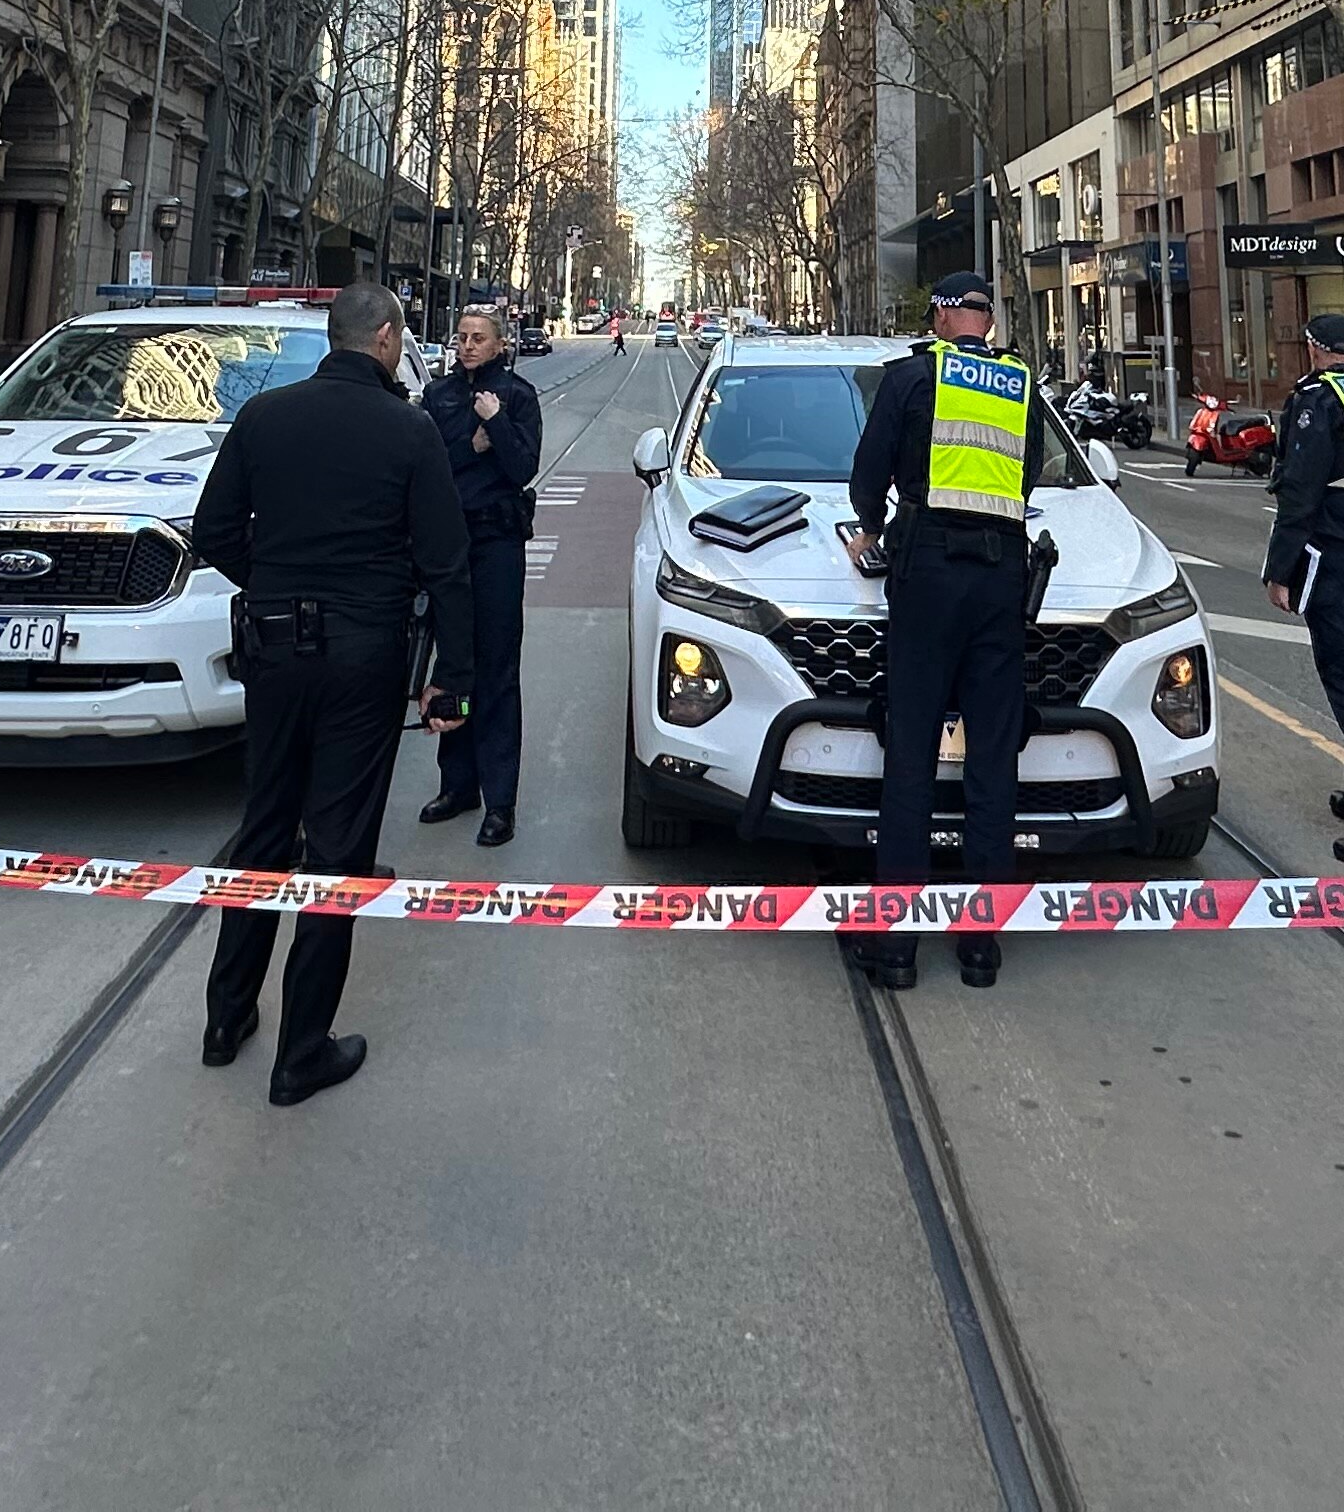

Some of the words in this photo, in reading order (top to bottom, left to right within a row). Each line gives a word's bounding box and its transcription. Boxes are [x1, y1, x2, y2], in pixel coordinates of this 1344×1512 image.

[1230, 236, 1318, 254] MDTdesign
[944, 356, 1024, 395] Police
[10, 623, 54, 650] 8FQ
[0, 855, 161, 890] DANGER
[202, 873, 362, 908] DANGER
[404, 885, 567, 920] DANGER
[613, 890, 778, 924] DANGER
[825, 891, 996, 924] DANGER
[1039, 886, 1220, 922] DANGER
